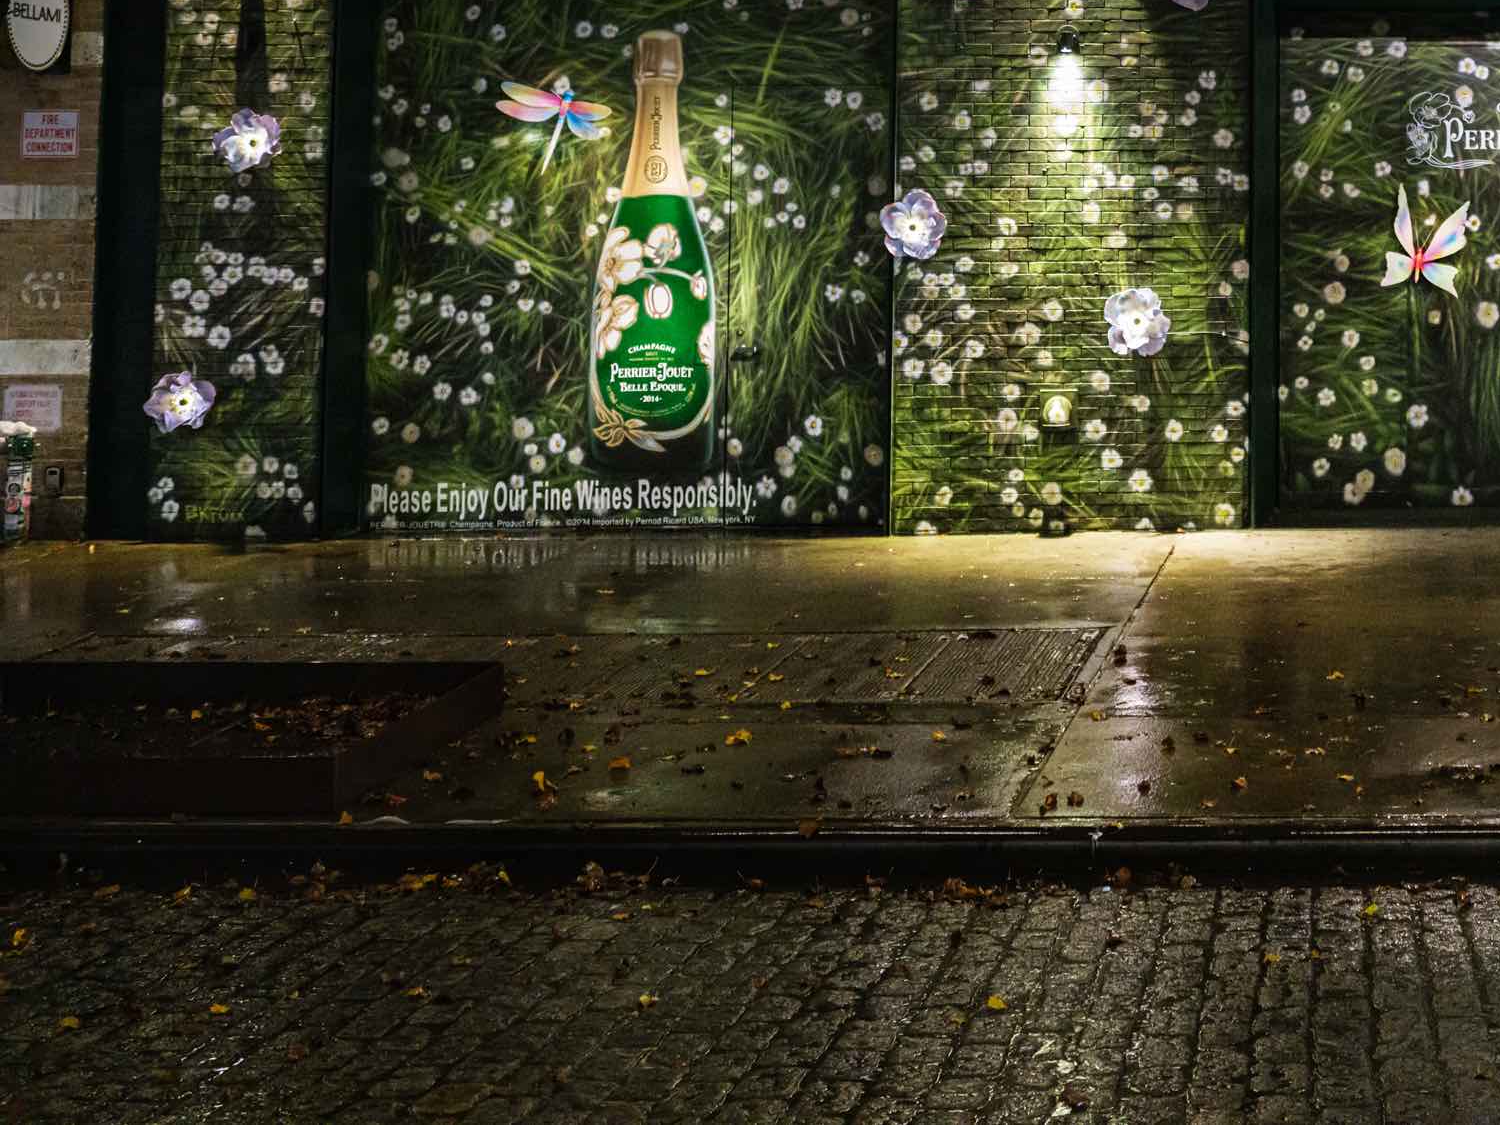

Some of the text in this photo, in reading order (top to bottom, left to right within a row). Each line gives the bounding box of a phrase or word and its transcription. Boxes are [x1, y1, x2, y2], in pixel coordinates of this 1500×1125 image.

[13, 2, 61, 23] BELLAMI
[628, 342, 676, 354] CHAMPAGNE
[619, 381, 649, 392] BELLE
[370, 475, 757, 520] Please Enjoy Our Fine Wines Responsibly.
